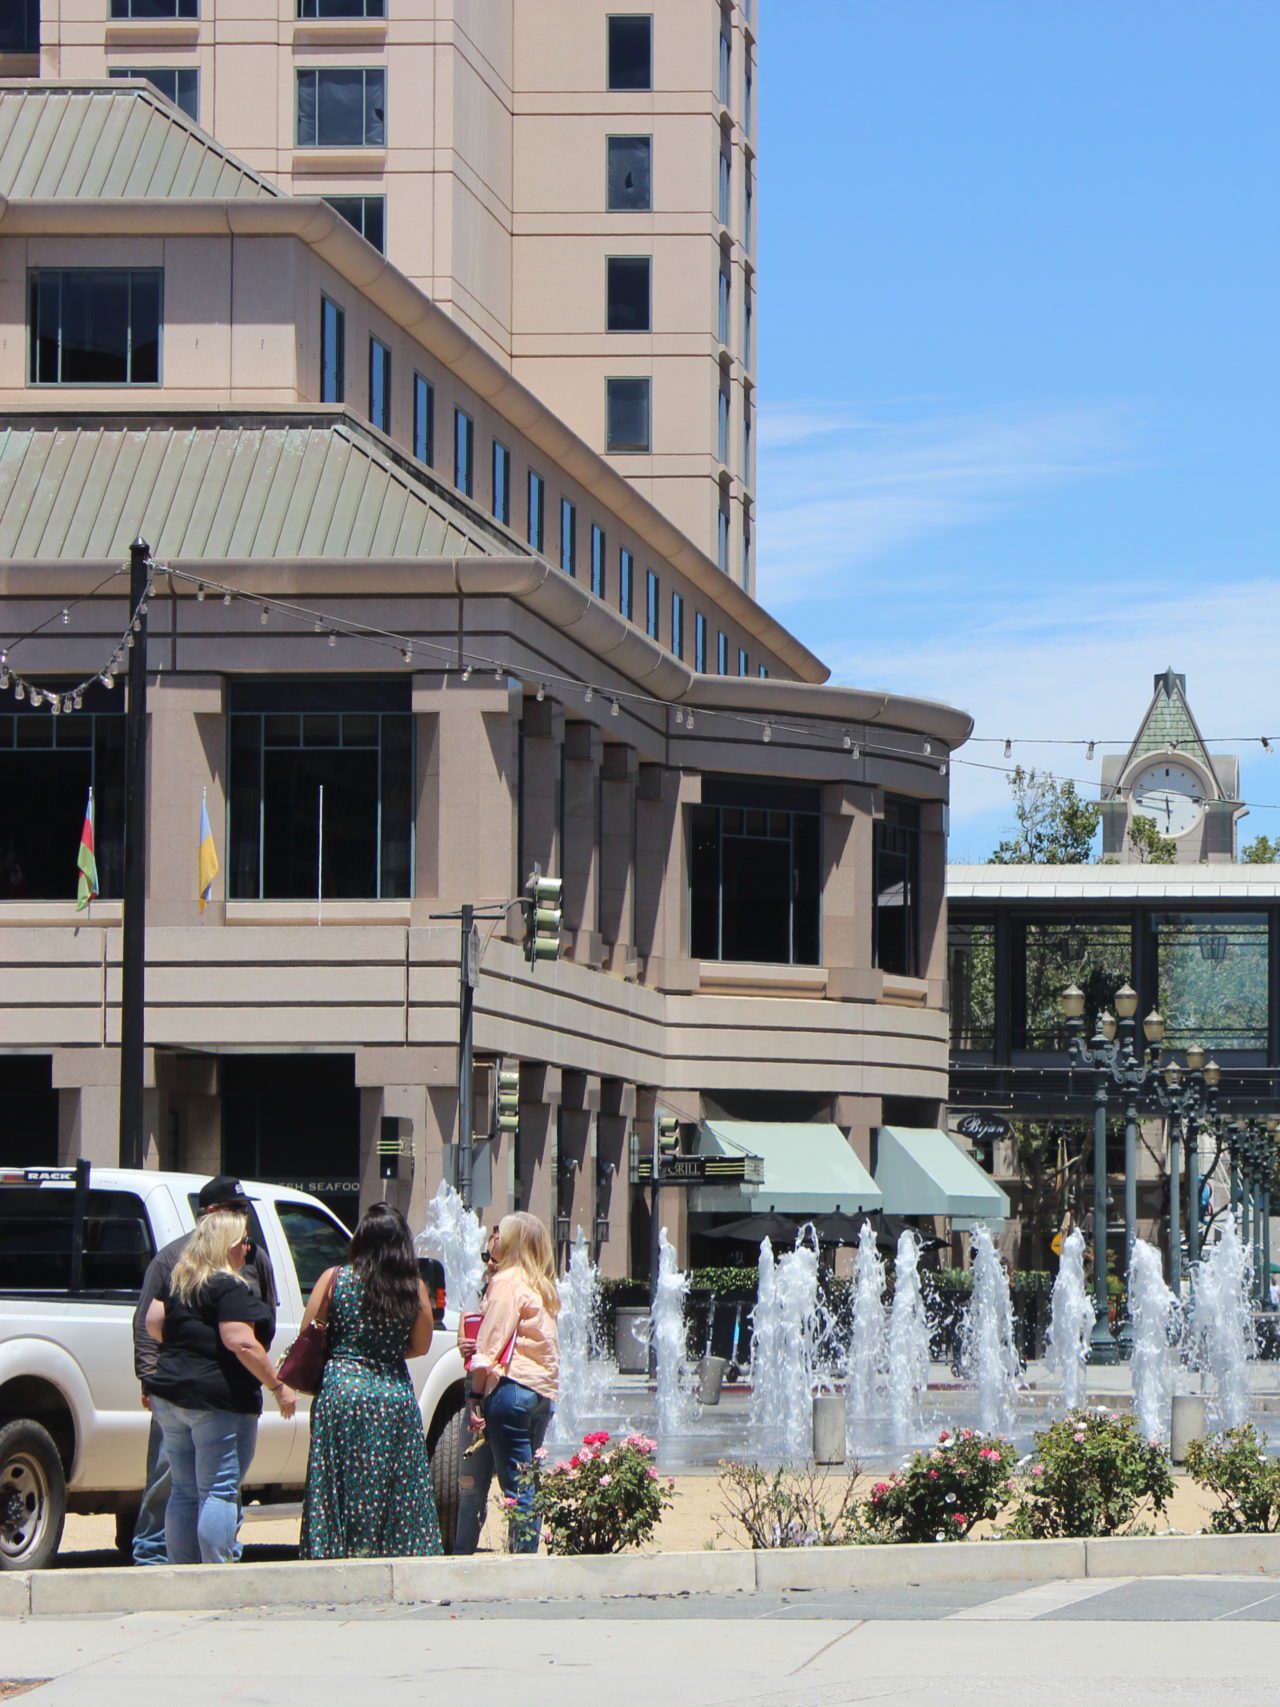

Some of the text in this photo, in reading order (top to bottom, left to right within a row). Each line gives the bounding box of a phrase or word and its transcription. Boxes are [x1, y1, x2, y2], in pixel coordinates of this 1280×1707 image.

[962, 1117, 1005, 1138] Bijan
[27, 1172, 73, 1180] RACK
[308, 1182, 360, 1192] SEAFOO
